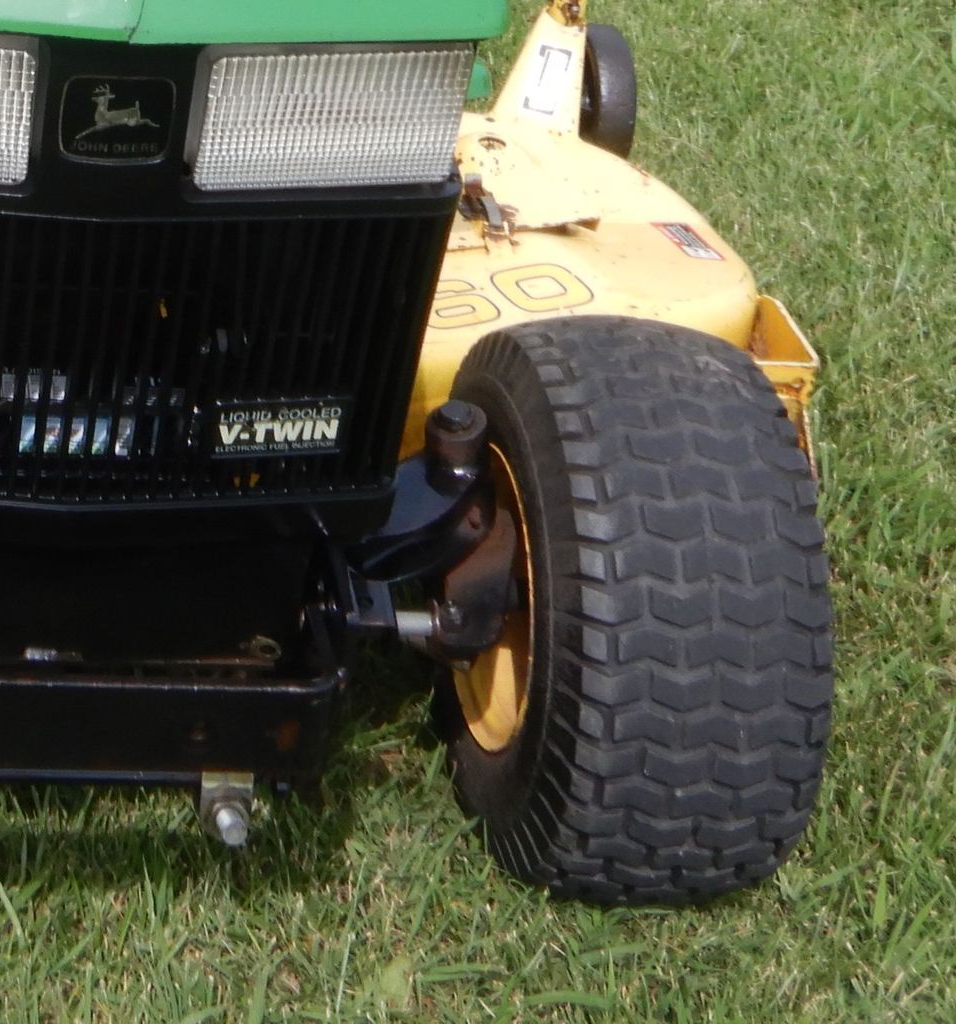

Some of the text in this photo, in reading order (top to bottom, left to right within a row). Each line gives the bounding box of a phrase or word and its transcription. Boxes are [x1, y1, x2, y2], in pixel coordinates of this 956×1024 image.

[69, 139, 158, 153] JOHN DEERE
[220, 407, 342, 423] LIQUID COOLED
[219, 418, 340, 445] V-TWIN
[215, 440, 335, 453] ELECTRONIC FUEL INJECTION
